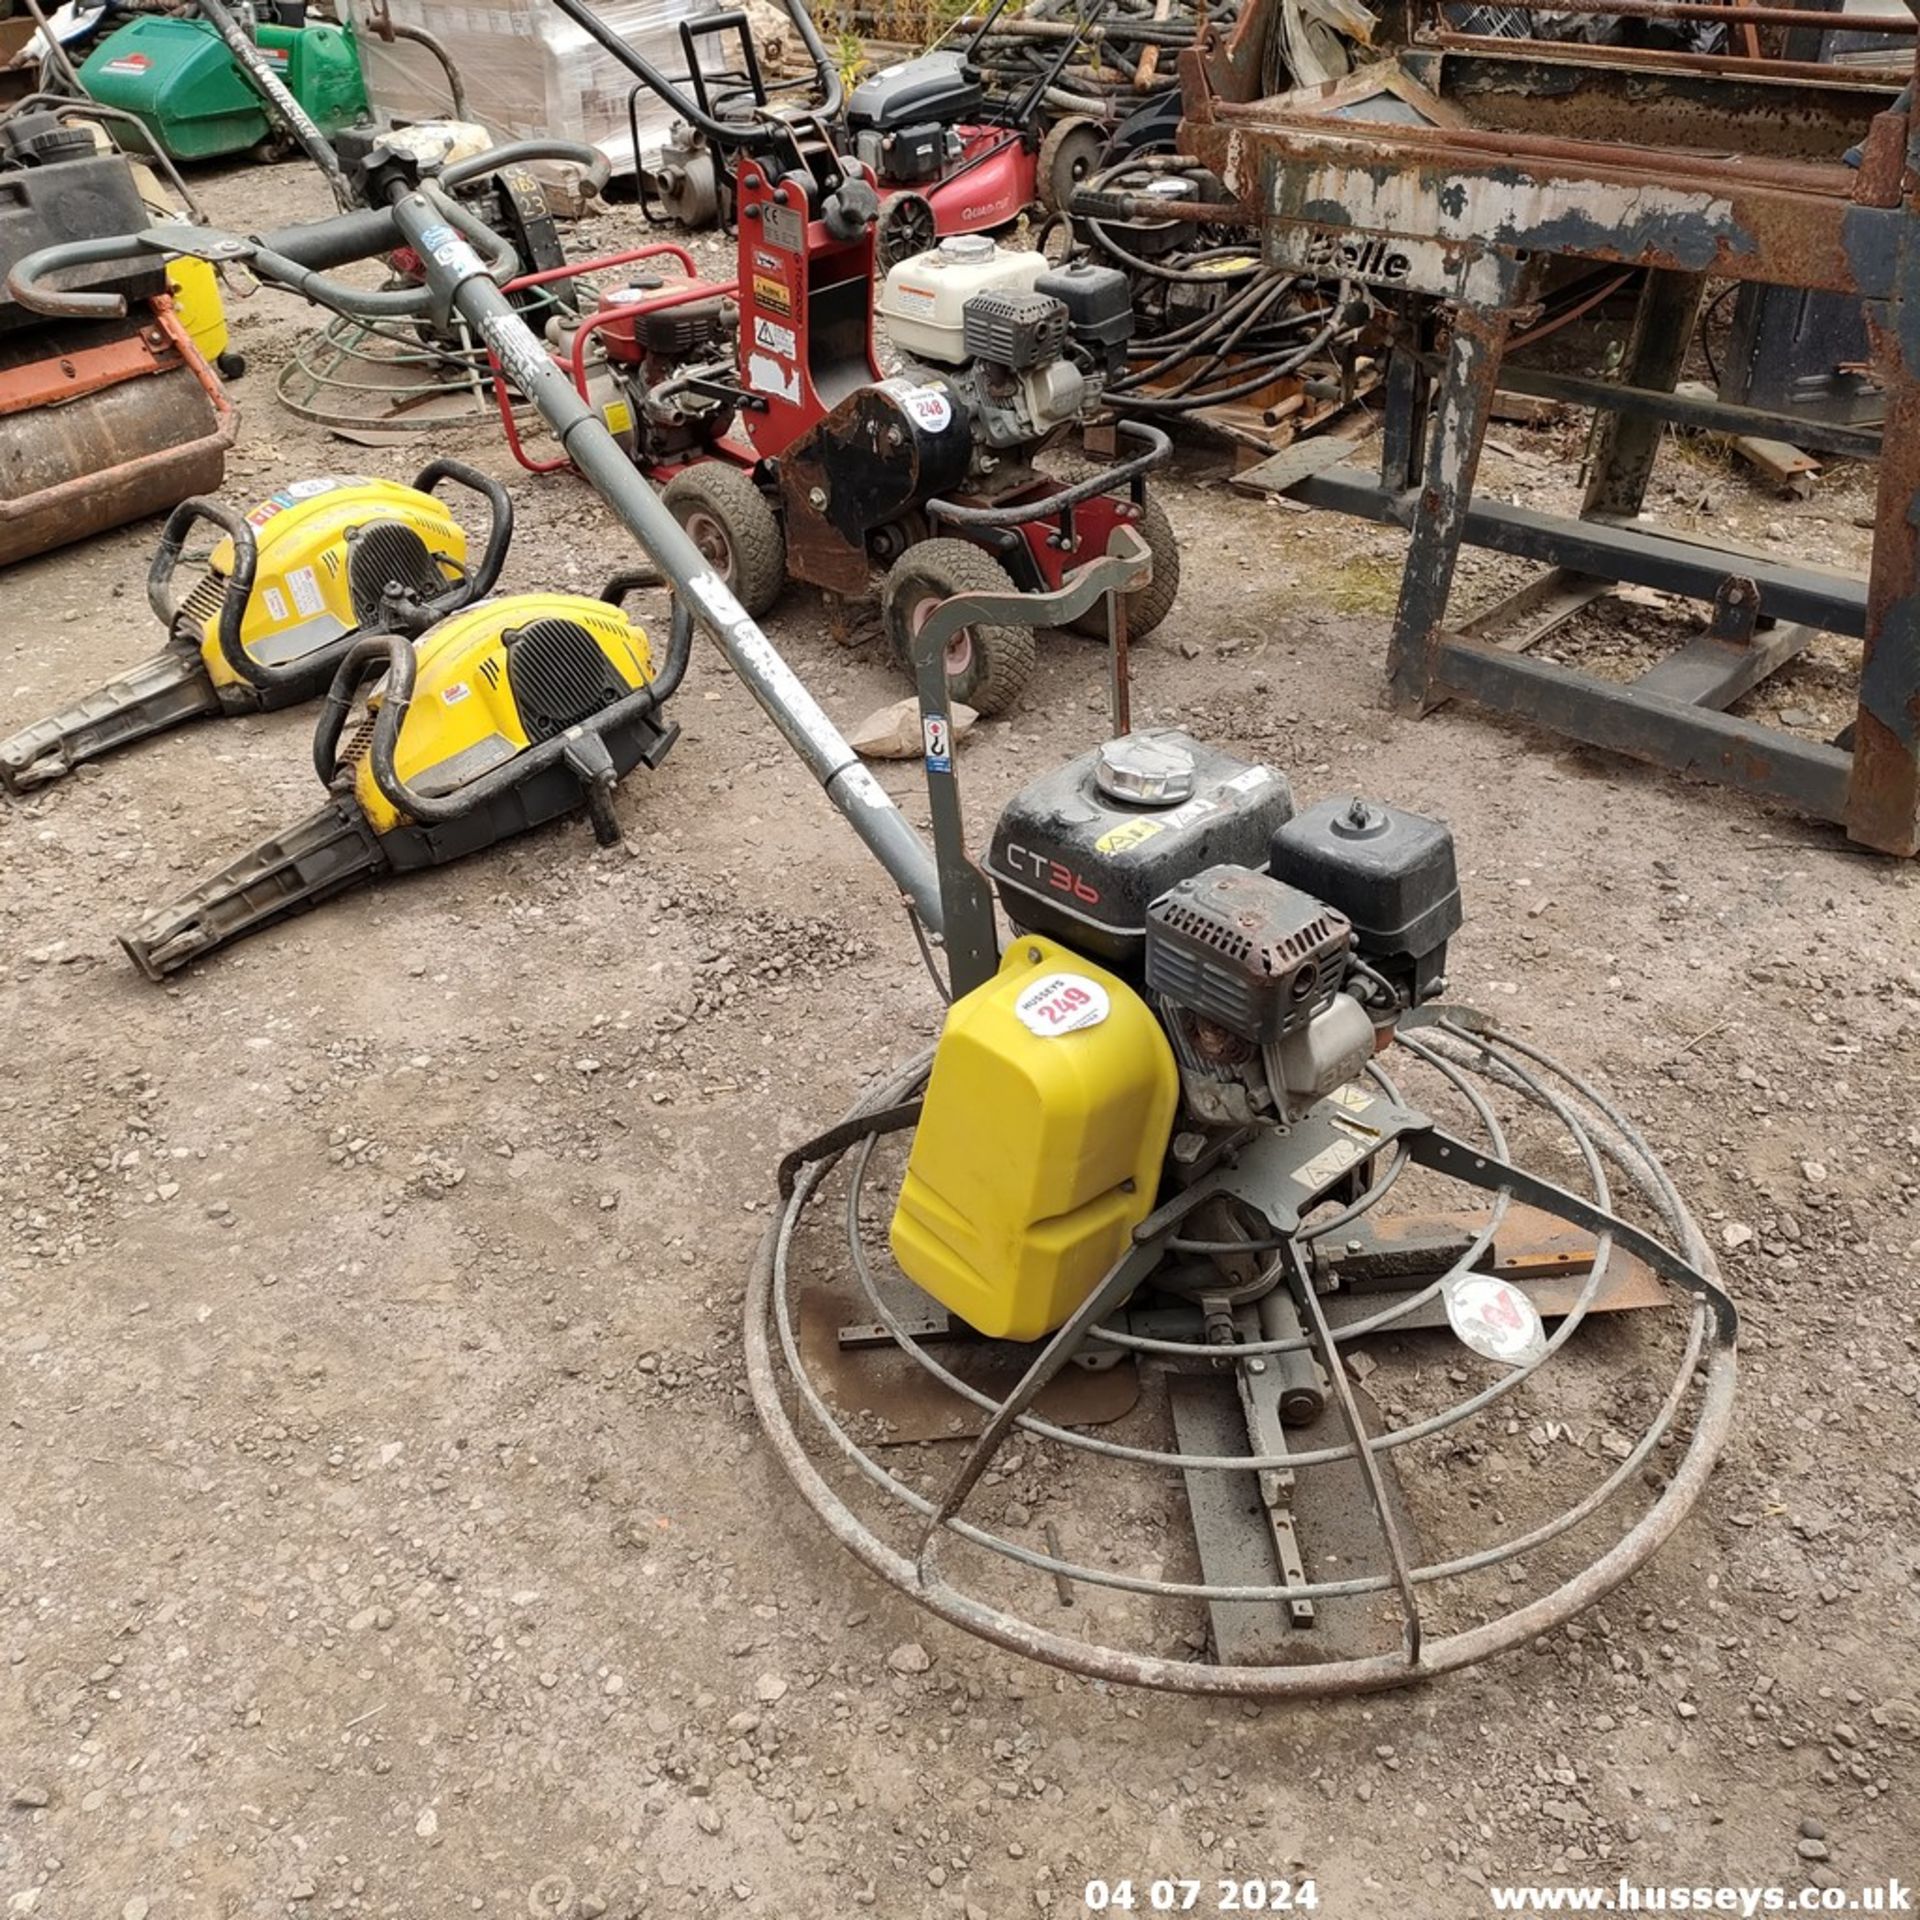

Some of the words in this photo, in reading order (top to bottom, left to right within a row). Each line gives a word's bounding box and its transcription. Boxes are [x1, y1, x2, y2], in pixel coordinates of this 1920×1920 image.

[916, 400, 944, 417] 248
[1007, 843, 1100, 905] CT36
[1022, 979, 1066, 1010] HUSSEYS
[1037, 987, 1092, 1025] 249
